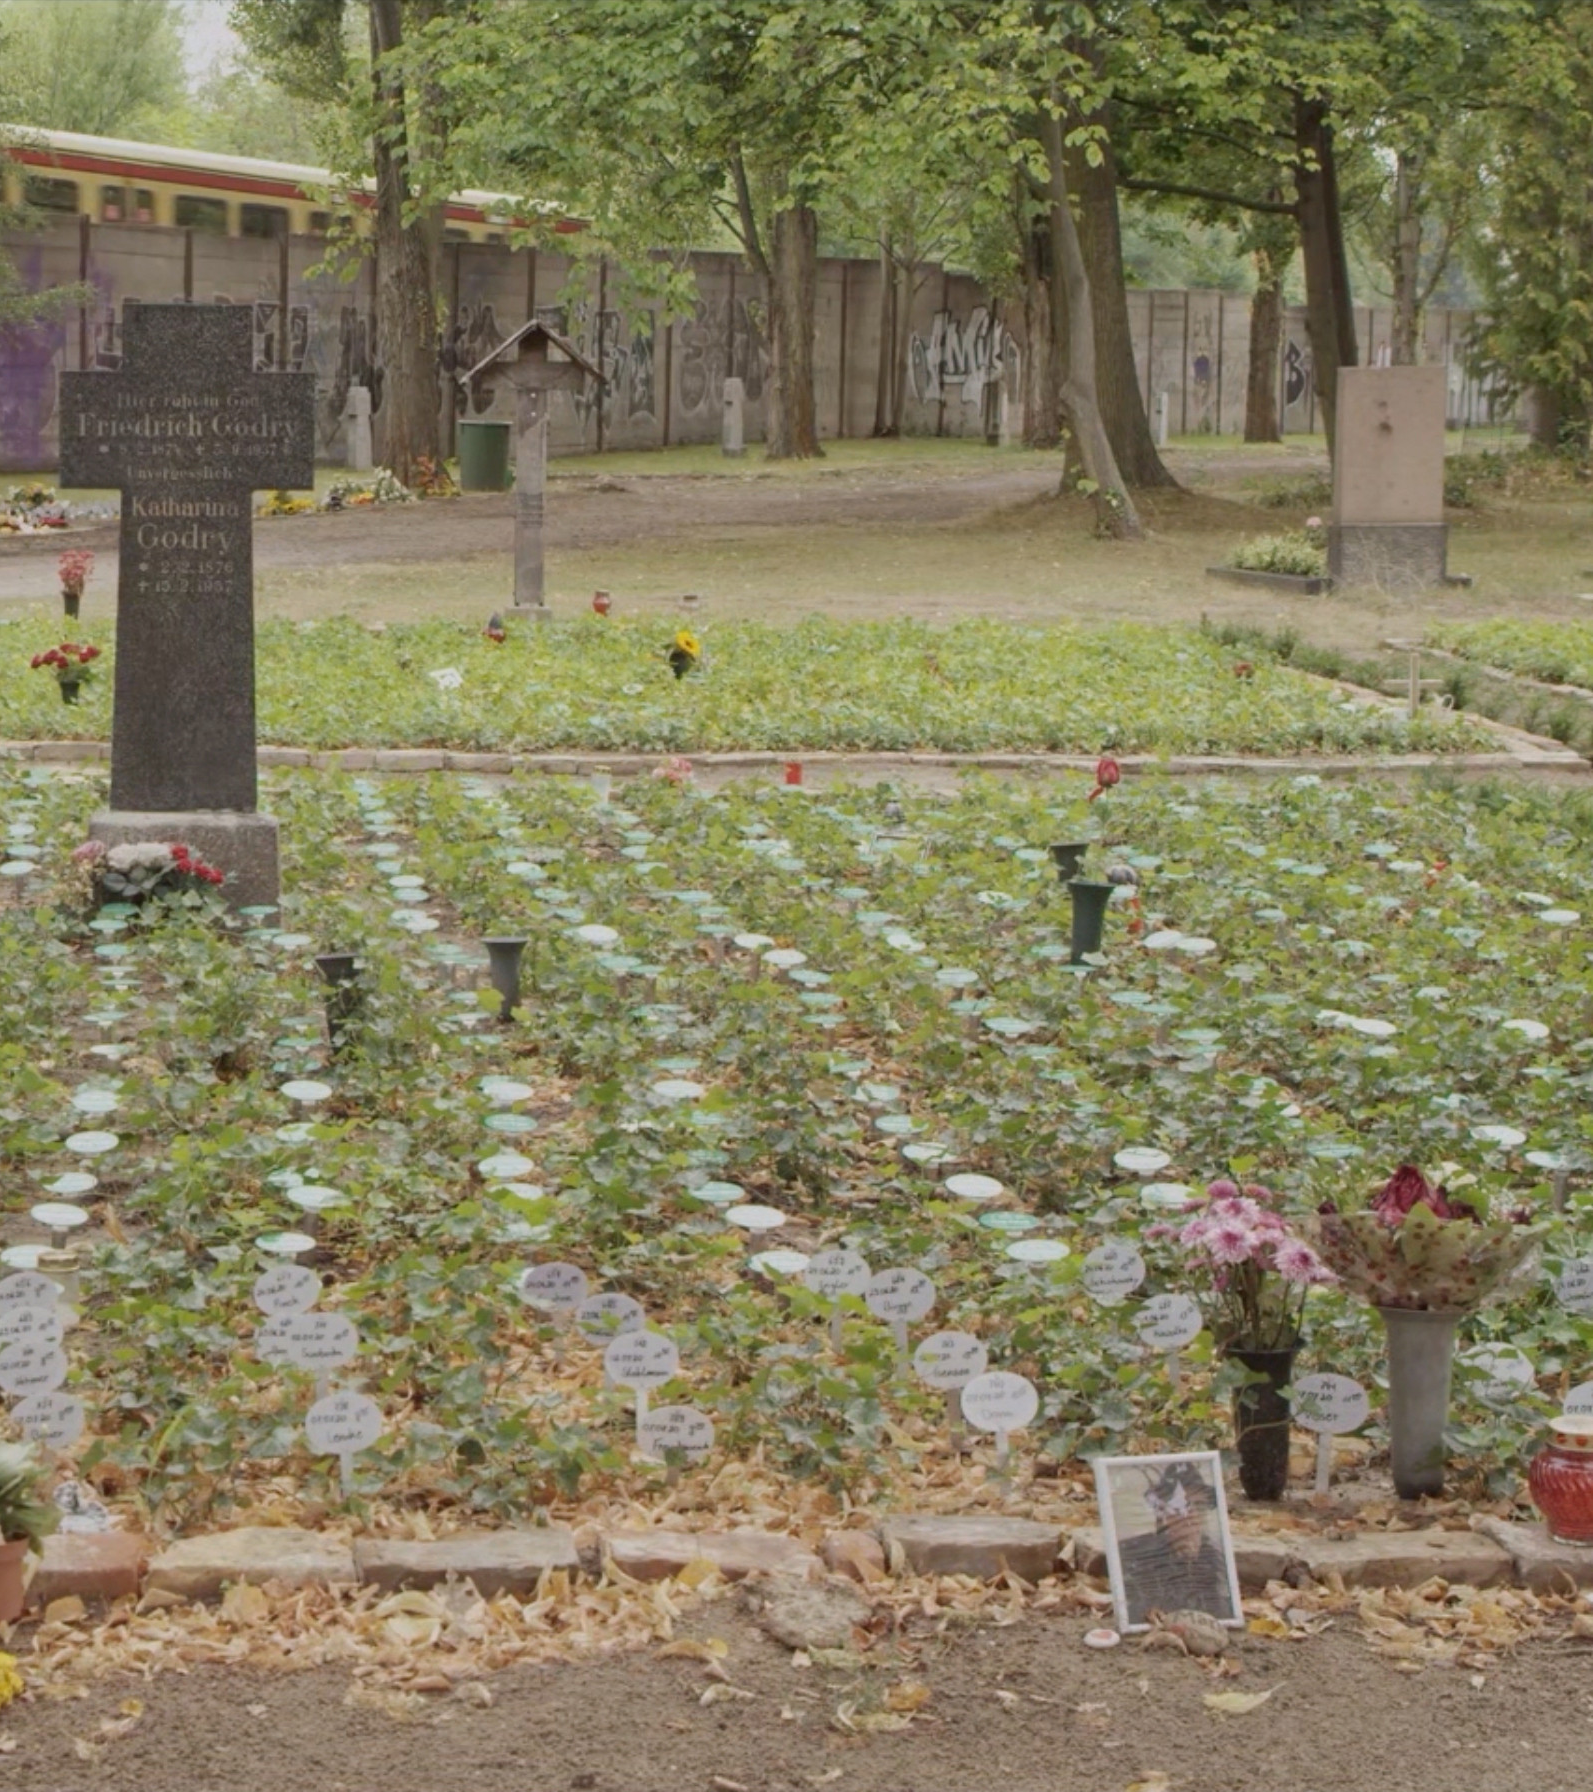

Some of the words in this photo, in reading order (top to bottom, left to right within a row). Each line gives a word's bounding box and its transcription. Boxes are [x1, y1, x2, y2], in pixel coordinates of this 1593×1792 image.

[78, 412, 203, 437] Friedrich
[211, 412, 297, 442] Godry
[132, 496, 239, 516] Katharina
[137, 522, 233, 555] Godry
